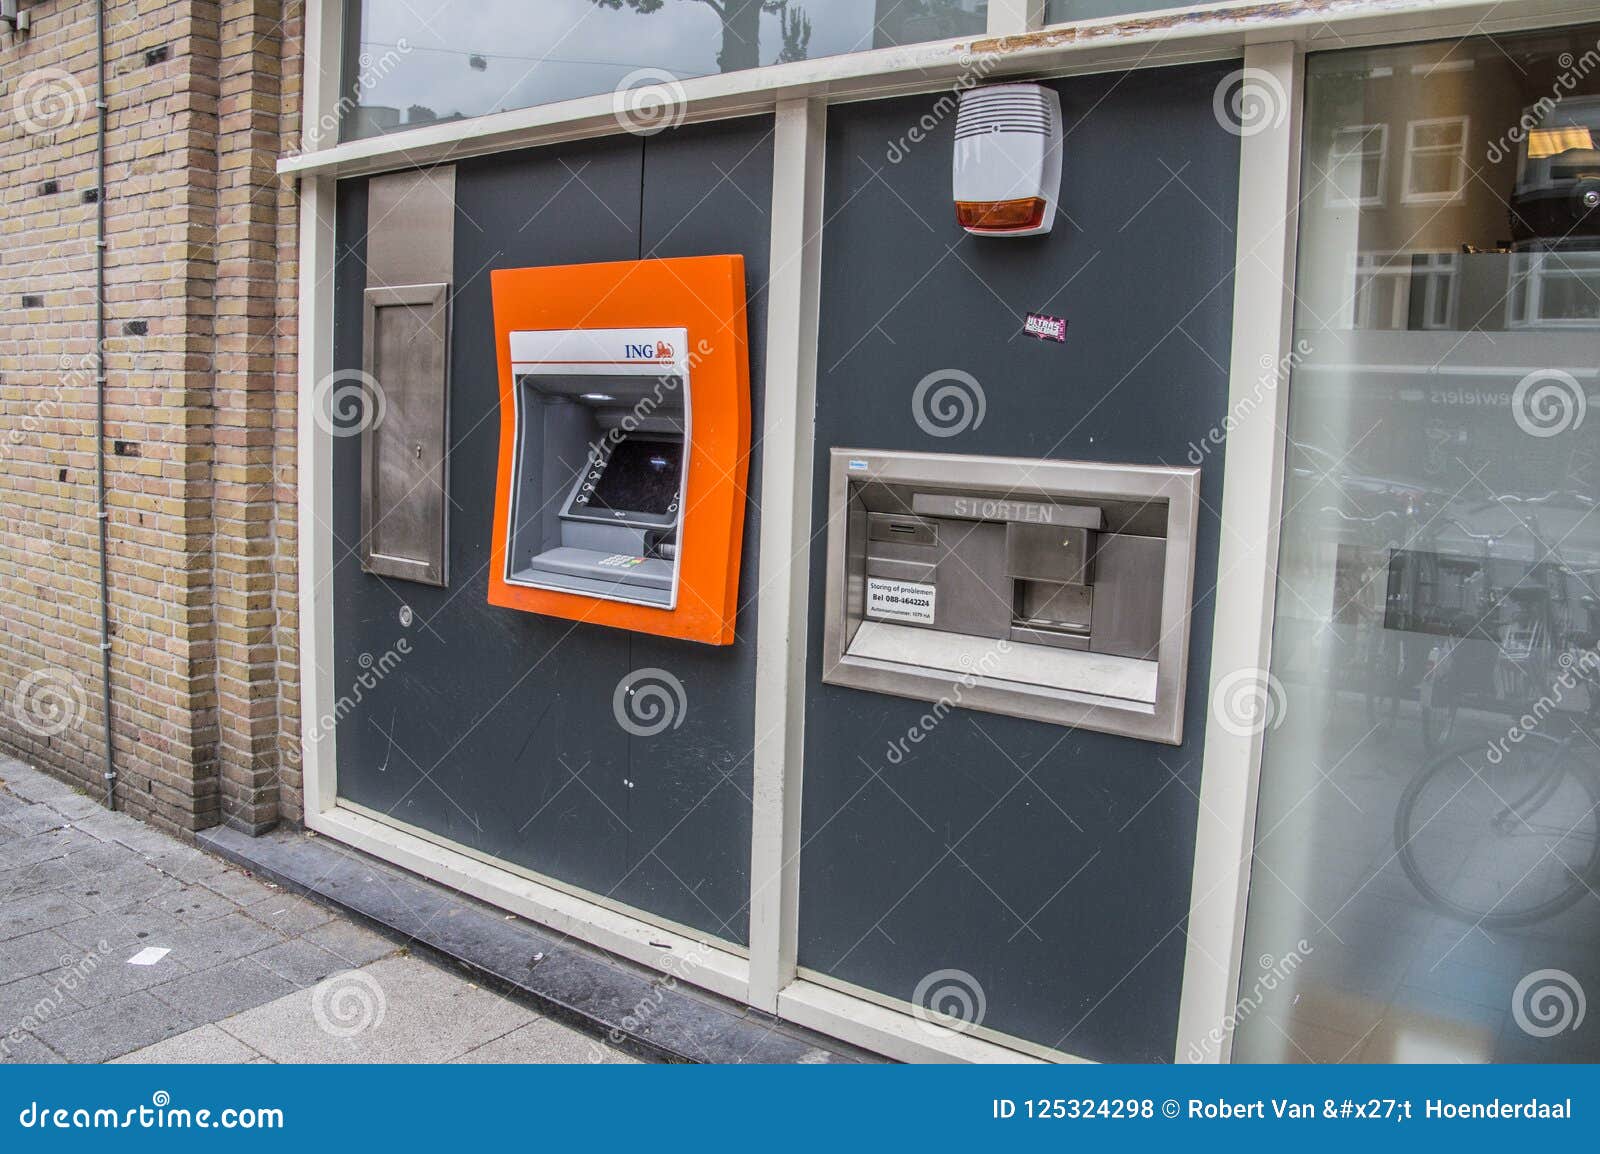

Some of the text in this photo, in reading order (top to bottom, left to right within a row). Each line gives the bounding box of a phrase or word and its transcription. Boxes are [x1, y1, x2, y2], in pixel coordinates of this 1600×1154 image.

[625, 344, 654, 359] ING
[953, 499, 1053, 523] STORTEN
[870, 582, 892, 593] Storing
[900, 586, 934, 596] problemen
[872, 593, 930, 607] Bel 088-4642224
